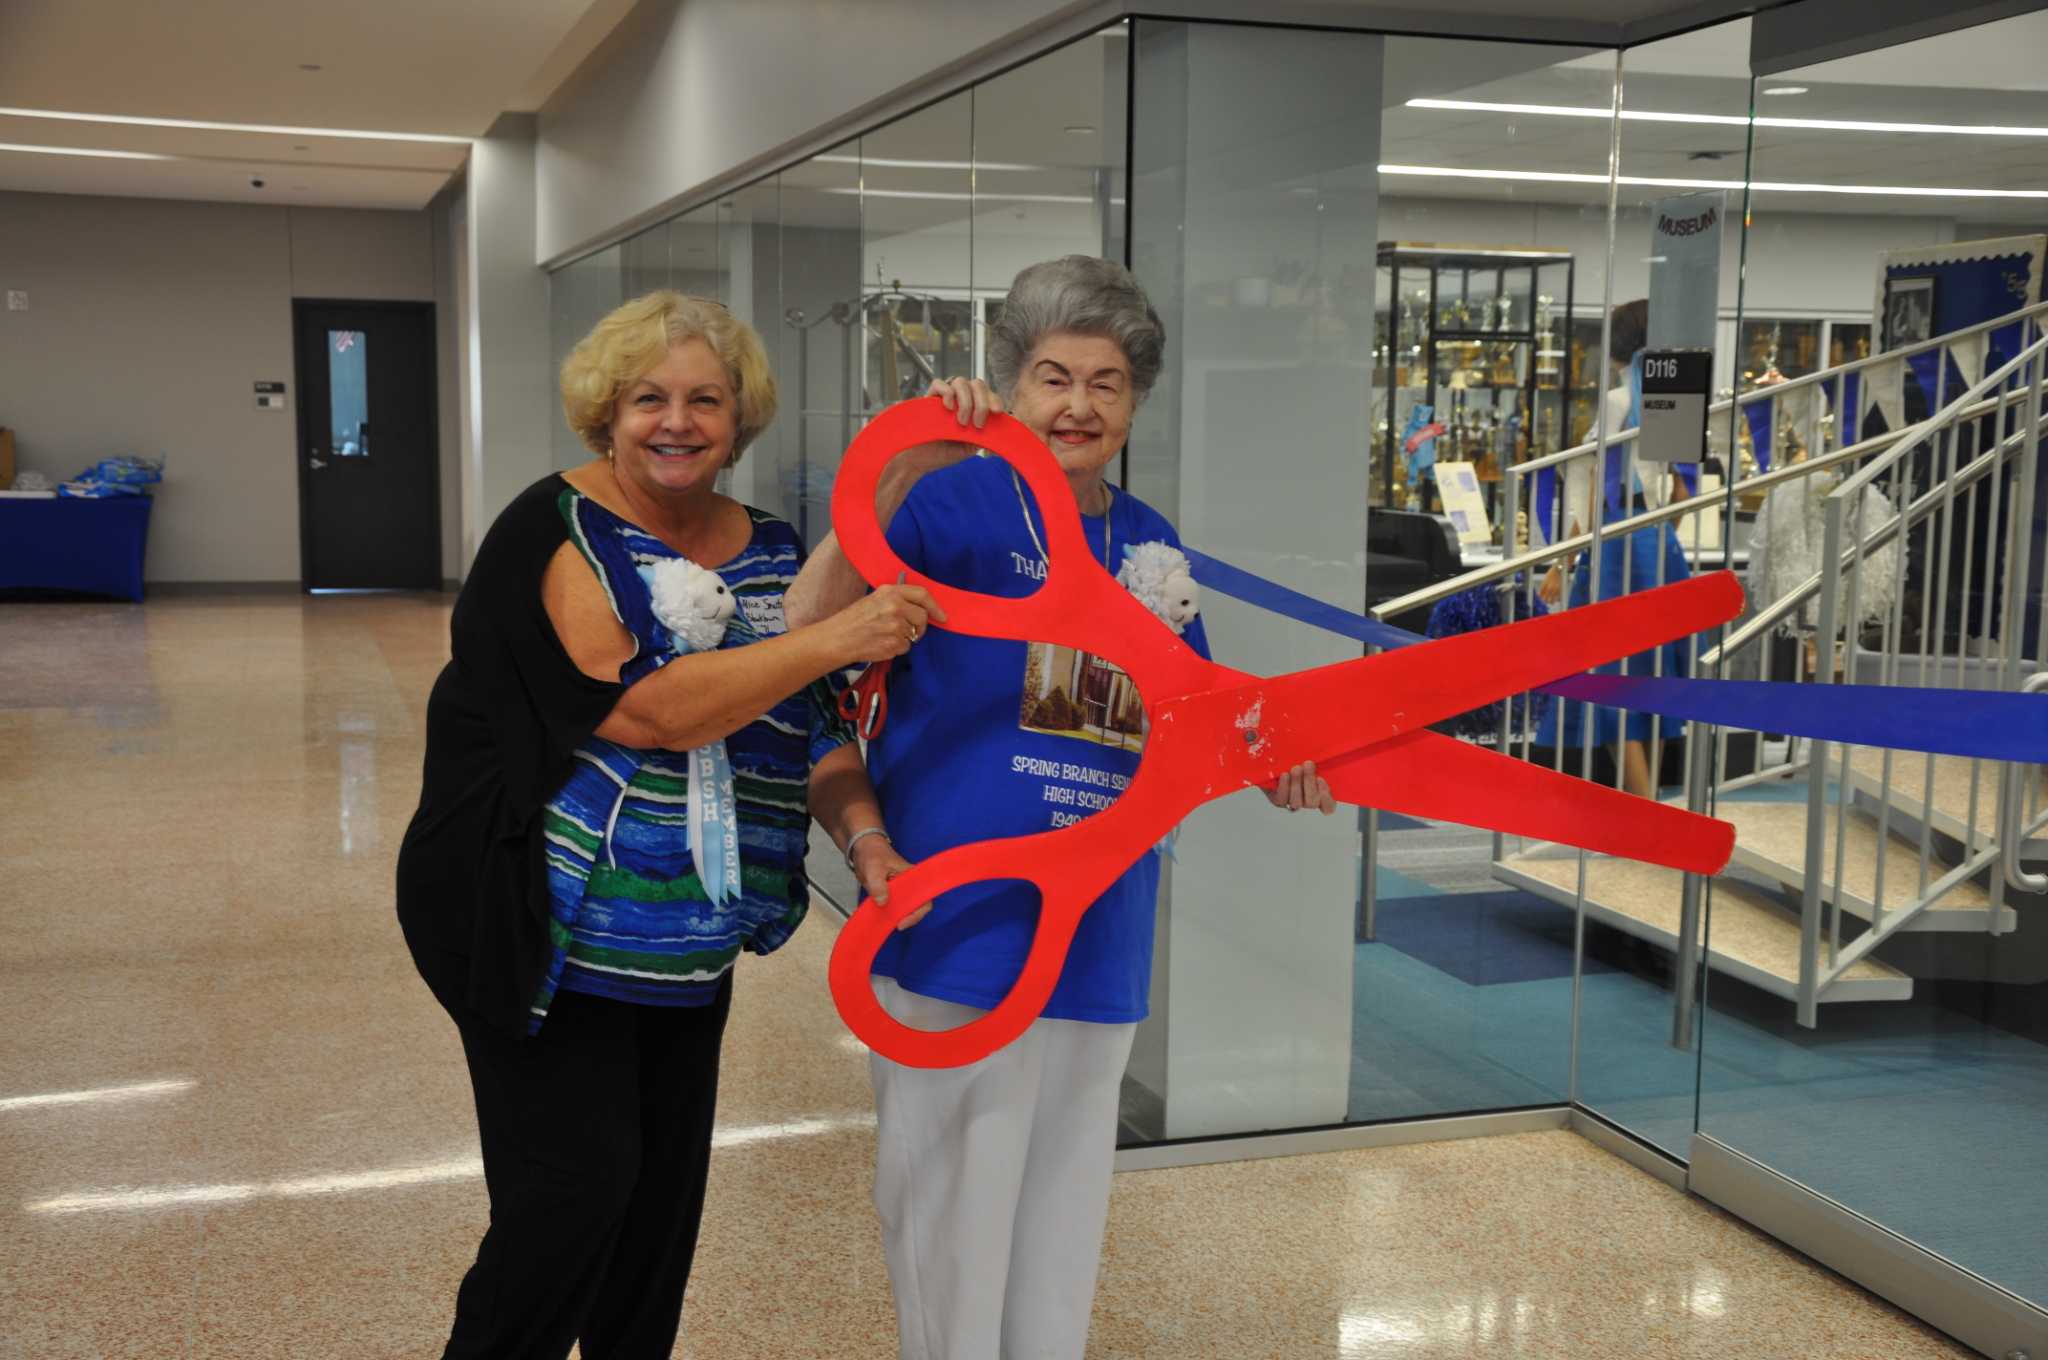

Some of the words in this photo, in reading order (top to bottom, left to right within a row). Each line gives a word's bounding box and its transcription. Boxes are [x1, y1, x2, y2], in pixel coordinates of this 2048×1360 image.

[1658, 207, 1717, 237] MUSEUM
[1645, 358, 1678, 378] D116
[1644, 399, 1676, 410] MUSEUM
[1011, 755, 1061, 779] SPRING
[1062, 763, 1110, 788] BRANCH
[1043, 784, 1076, 805] HIGH
[1076, 789, 1119, 812] SCHOO
[720, 779, 737, 885] MEMBER
